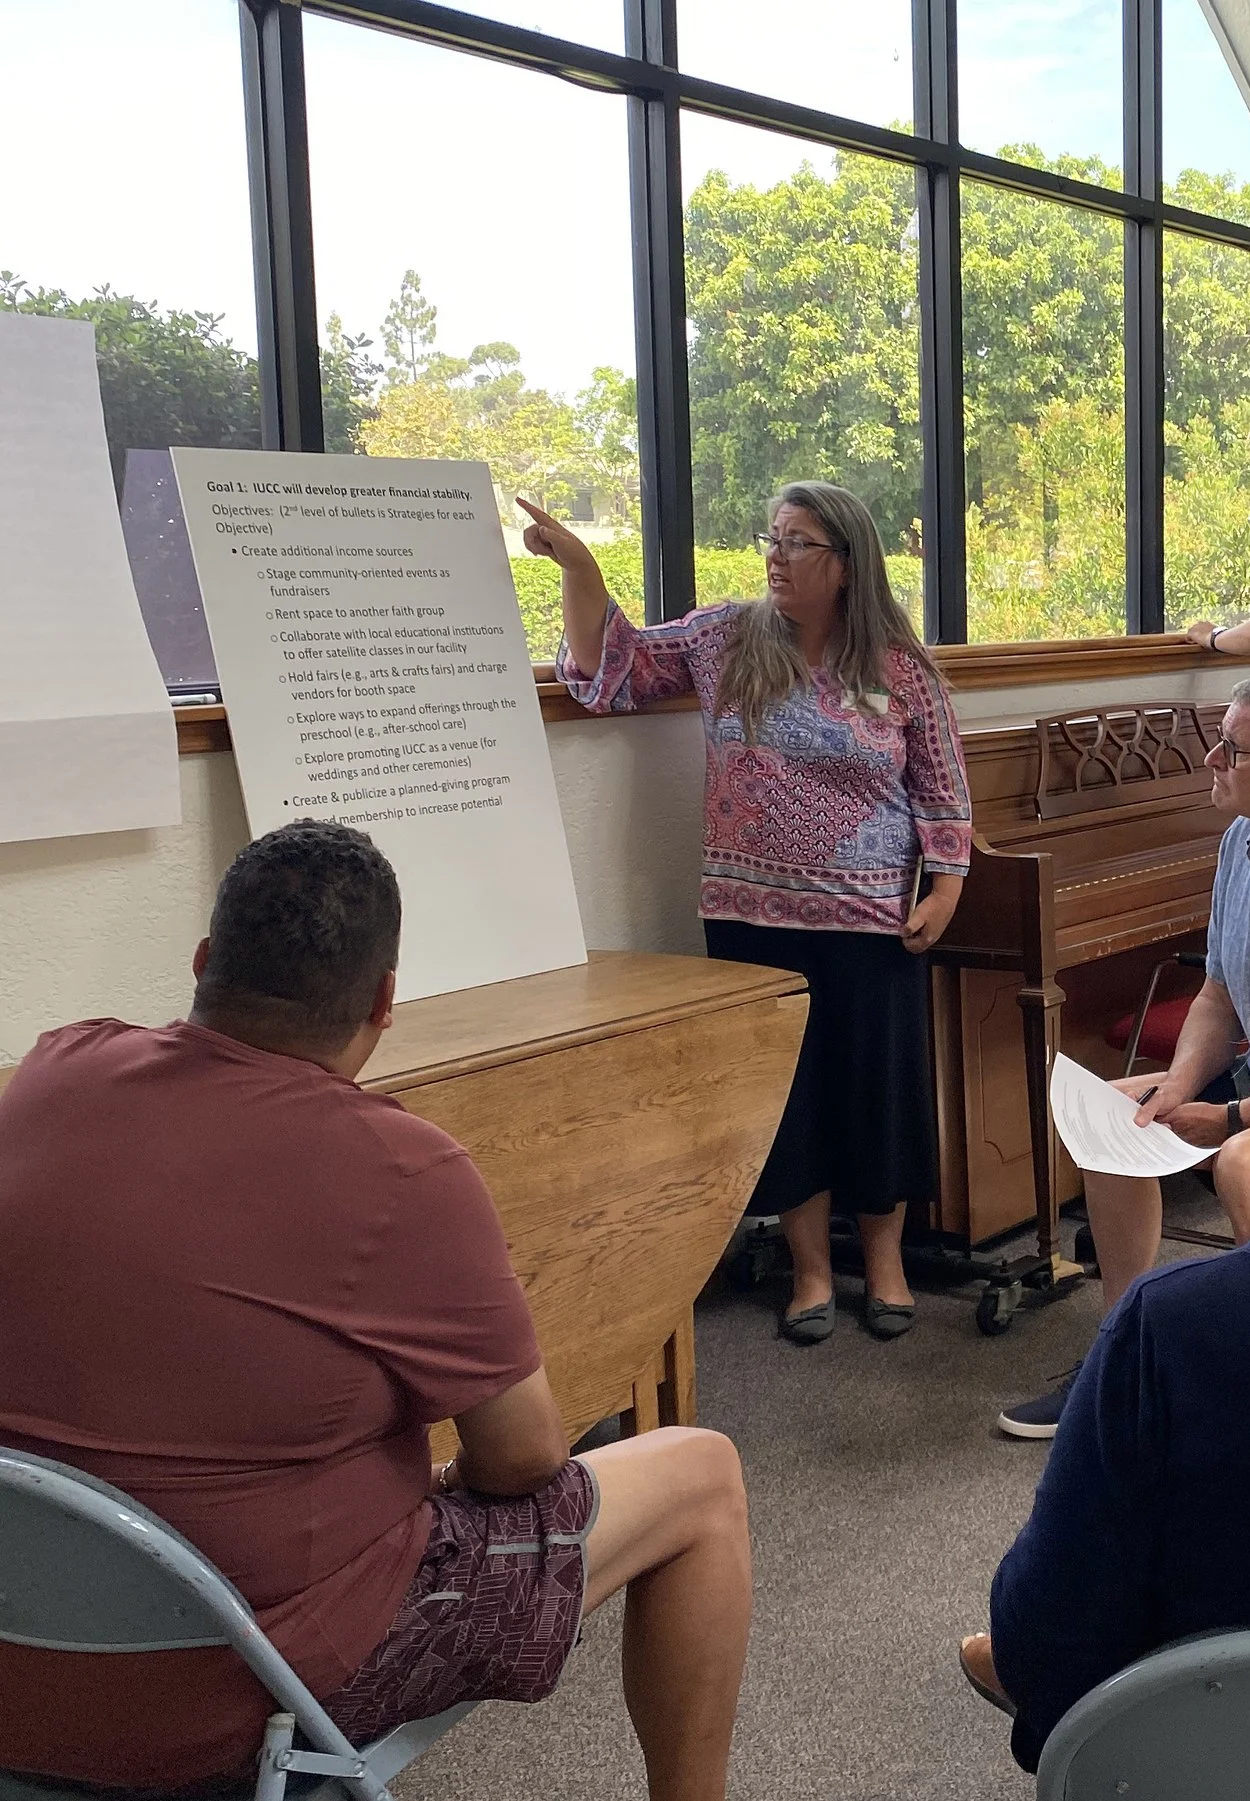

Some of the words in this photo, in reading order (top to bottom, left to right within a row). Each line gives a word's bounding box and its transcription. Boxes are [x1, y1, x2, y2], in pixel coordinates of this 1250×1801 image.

[207, 481, 234, 493] Goal
[253, 483, 281, 493] IUCC
[282, 484, 303, 494] will
[305, 484, 347, 497] develop
[350, 487, 386, 498] greater
[389, 487, 430, 498] financial
[301, 506, 326, 517] level
[328, 506, 339, 517] of
[341, 507, 375, 518] bullets
[378, 508, 385, 518] is
[388, 508, 434, 521] Strategies
[437, 509, 450, 519] for
[452, 510, 475, 520] each
[215, 522, 273, 536] Objective)
[241, 546, 278, 557] Create
[281, 545, 333, 557] additional
[335, 546, 373, 557] income
[375, 547, 414, 557] sources
[266, 568, 297, 581] Stage
[300, 567, 404, 580] community-oriented
[406, 569, 438, 578] events
[440, 569, 450, 578] as
[270, 585, 330, 597] fundraisers
[275, 608, 300, 619] Rent
[303, 609, 333, 620] space
[335, 608, 347, 618] to
[349, 606, 389, 618] another
[392, 605, 414, 616] faith
[416, 607, 445, 618] group
[280, 630, 341, 642] Collaborate
[343, 629, 367, 640] with
[368, 628, 392, 639] local
[394, 626, 450, 638] educational
[452, 625, 504, 636] institutions
[283, 650, 295, 660] to
[298, 648, 323, 659] offer
[326, 646, 367, 658] satellite
[369, 645, 403, 657] classes
[406, 644, 415, 654] in
[417, 645, 433, 654] our
[436, 643, 467, 654] facility
[288, 671, 313, 682] Hold
[316, 670, 339, 681] fairs
[369, 669, 389, 678] arts
[391, 667, 400, 676] &
[402, 665, 429, 677] crafts
[431, 664, 455, 676] fairs)
[457, 663, 474, 674] and
[477, 662, 508, 674] charge
[291, 689, 335, 700] vendors
[337, 687, 351, 697] for
[354, 685, 385, 696] booth
[388, 685, 416, 696] space
[296, 711, 336, 724] Explore
[339, 710, 364, 721] ways
[367, 708, 378, 718] to
[380, 705, 416, 718] expand
[419, 703, 460, 714] offerings
[462, 699, 499, 712] through
[501, 698, 516, 708] the
[300, 726, 352, 743] preschool
[383, 719, 440, 734] after-school
[443, 718, 466, 730] care)
[304, 751, 344, 764] Explore
[347, 747, 400, 762] promoting
[402, 743, 426, 755] IUCC
[429, 743, 439, 752] as
[442, 743, 447, 751] a
[449, 740, 478, 750] venue
[481, 737, 496, 749] (for
[308, 768, 358, 781] weddings
[361, 765, 380, 776] and
[383, 763, 409, 774] other
[413, 756, 471, 771] ceremonies)
[292, 794, 328, 806] Create
[331, 792, 340, 802] &
[343, 788, 387, 802] publicize
[390, 787, 395, 796] a
[399, 779, 469, 797] planned-giving
[472, 775, 511, 789] program
[339, 808, 403, 825] membership
[406, 807, 416, 816] to
[419, 802, 459, 815] increase
[461, 795, 503, 812] potential
